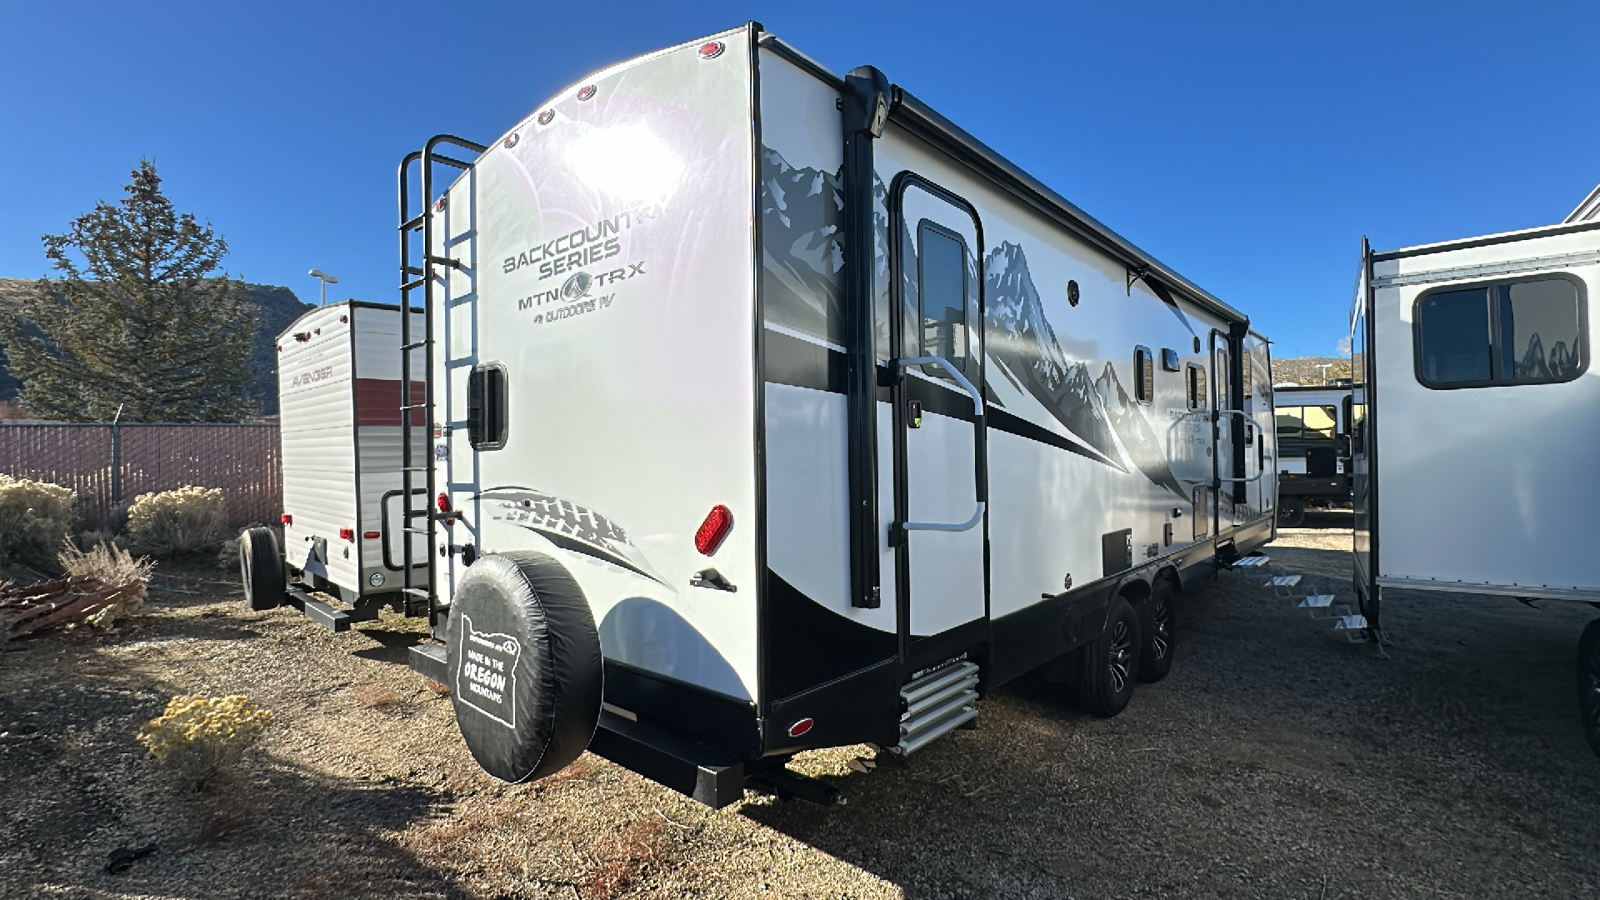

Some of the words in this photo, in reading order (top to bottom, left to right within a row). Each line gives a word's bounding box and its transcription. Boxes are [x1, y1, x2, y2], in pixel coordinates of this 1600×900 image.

[503, 197, 669, 274] BACKCOUNT
[538, 236, 621, 281] SERIES
[518, 287, 559, 311] MTN
[594, 260, 646, 287] TRX
[545, 298, 597, 323] OUTDOORS
[291, 365, 334, 388] AVENGER
[467, 649, 484, 664] MADE
[484, 656, 492, 667] IN
[491, 658, 504, 672] THE
[464, 661, 506, 692] OREGON
[469, 682, 503, 704] MOUNTAINS
